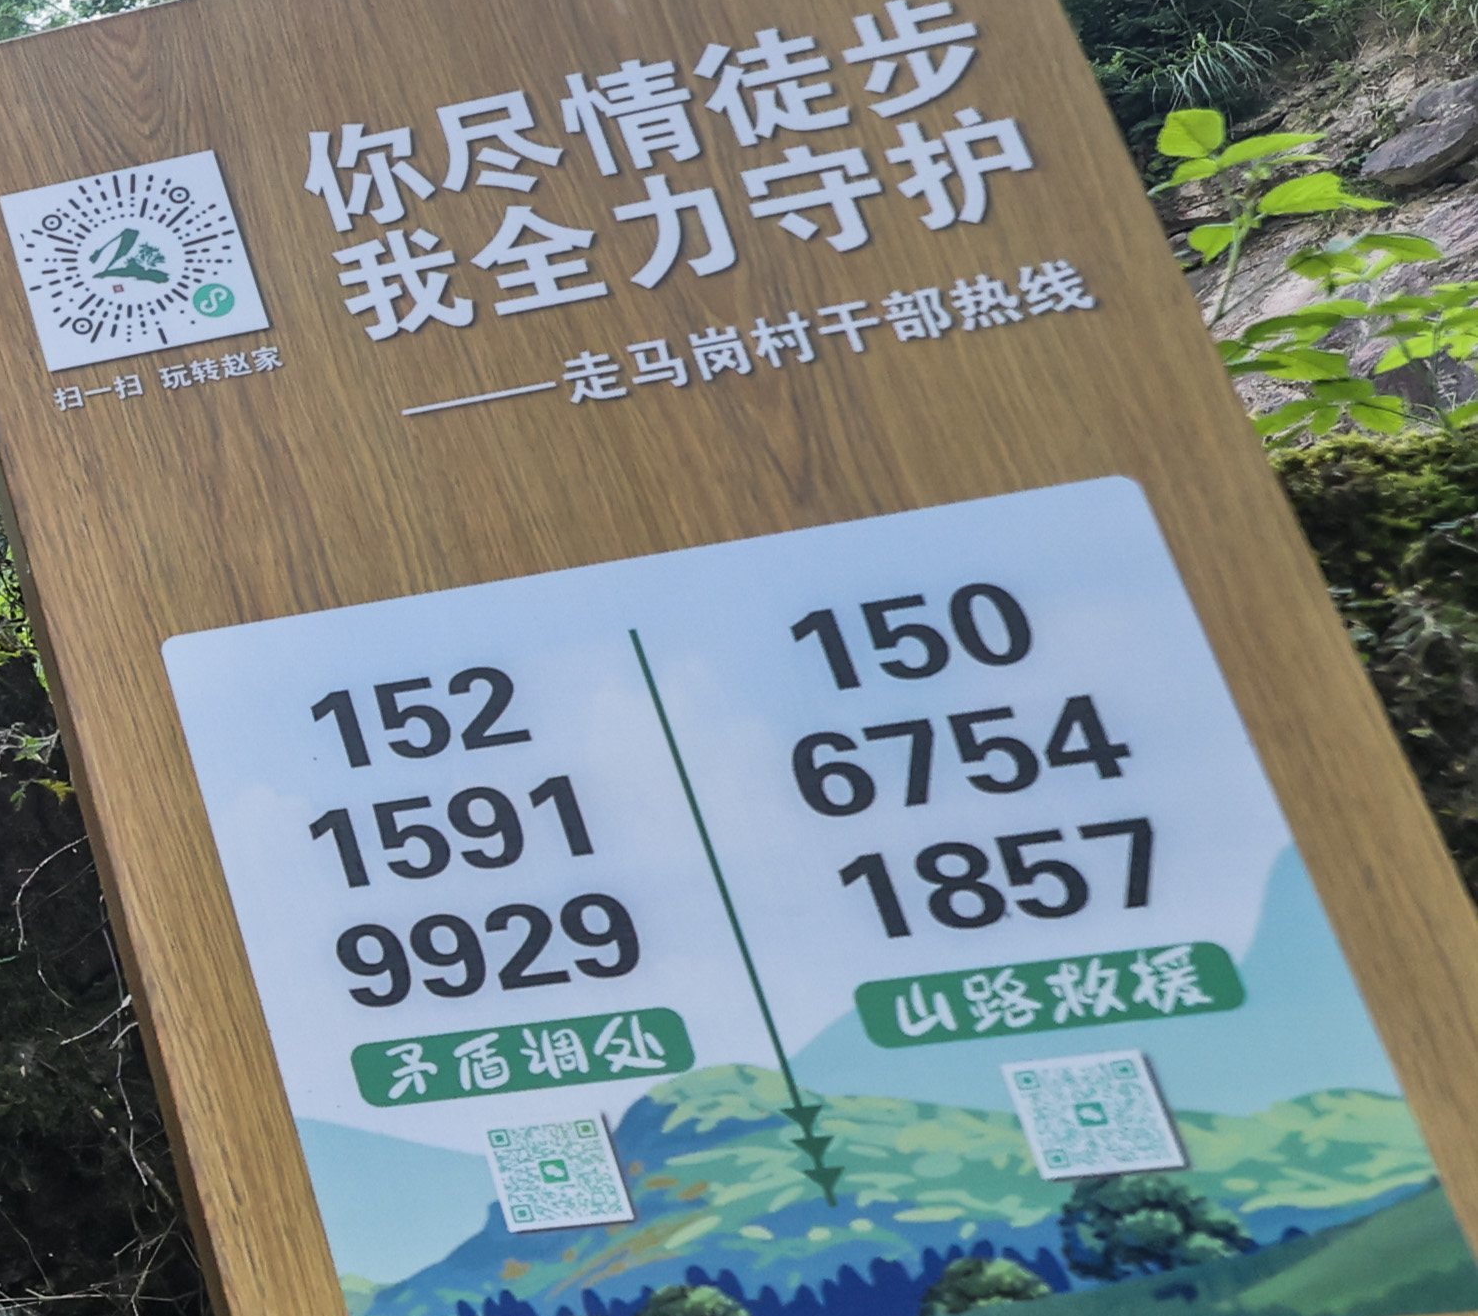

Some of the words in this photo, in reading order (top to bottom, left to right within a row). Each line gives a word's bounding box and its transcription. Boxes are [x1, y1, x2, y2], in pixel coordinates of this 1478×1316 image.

[332, 107, 1036, 347] 我全力守护
[53, 374, 144, 411] 扫一扫
[159, 345, 284, 390] 玩转赵家
[791, 582, 1034, 692] 150
[308, 665, 532, 770] 152
[792, 695, 1131, 818] 6754
[308, 774, 596, 890] 1591
[839, 816, 1158, 940] 1857
[334, 891, 641, 1009] 9929
[894, 944, 1212, 1037] 山路救援
[385, 1014, 668, 1100] 矛盾调处
